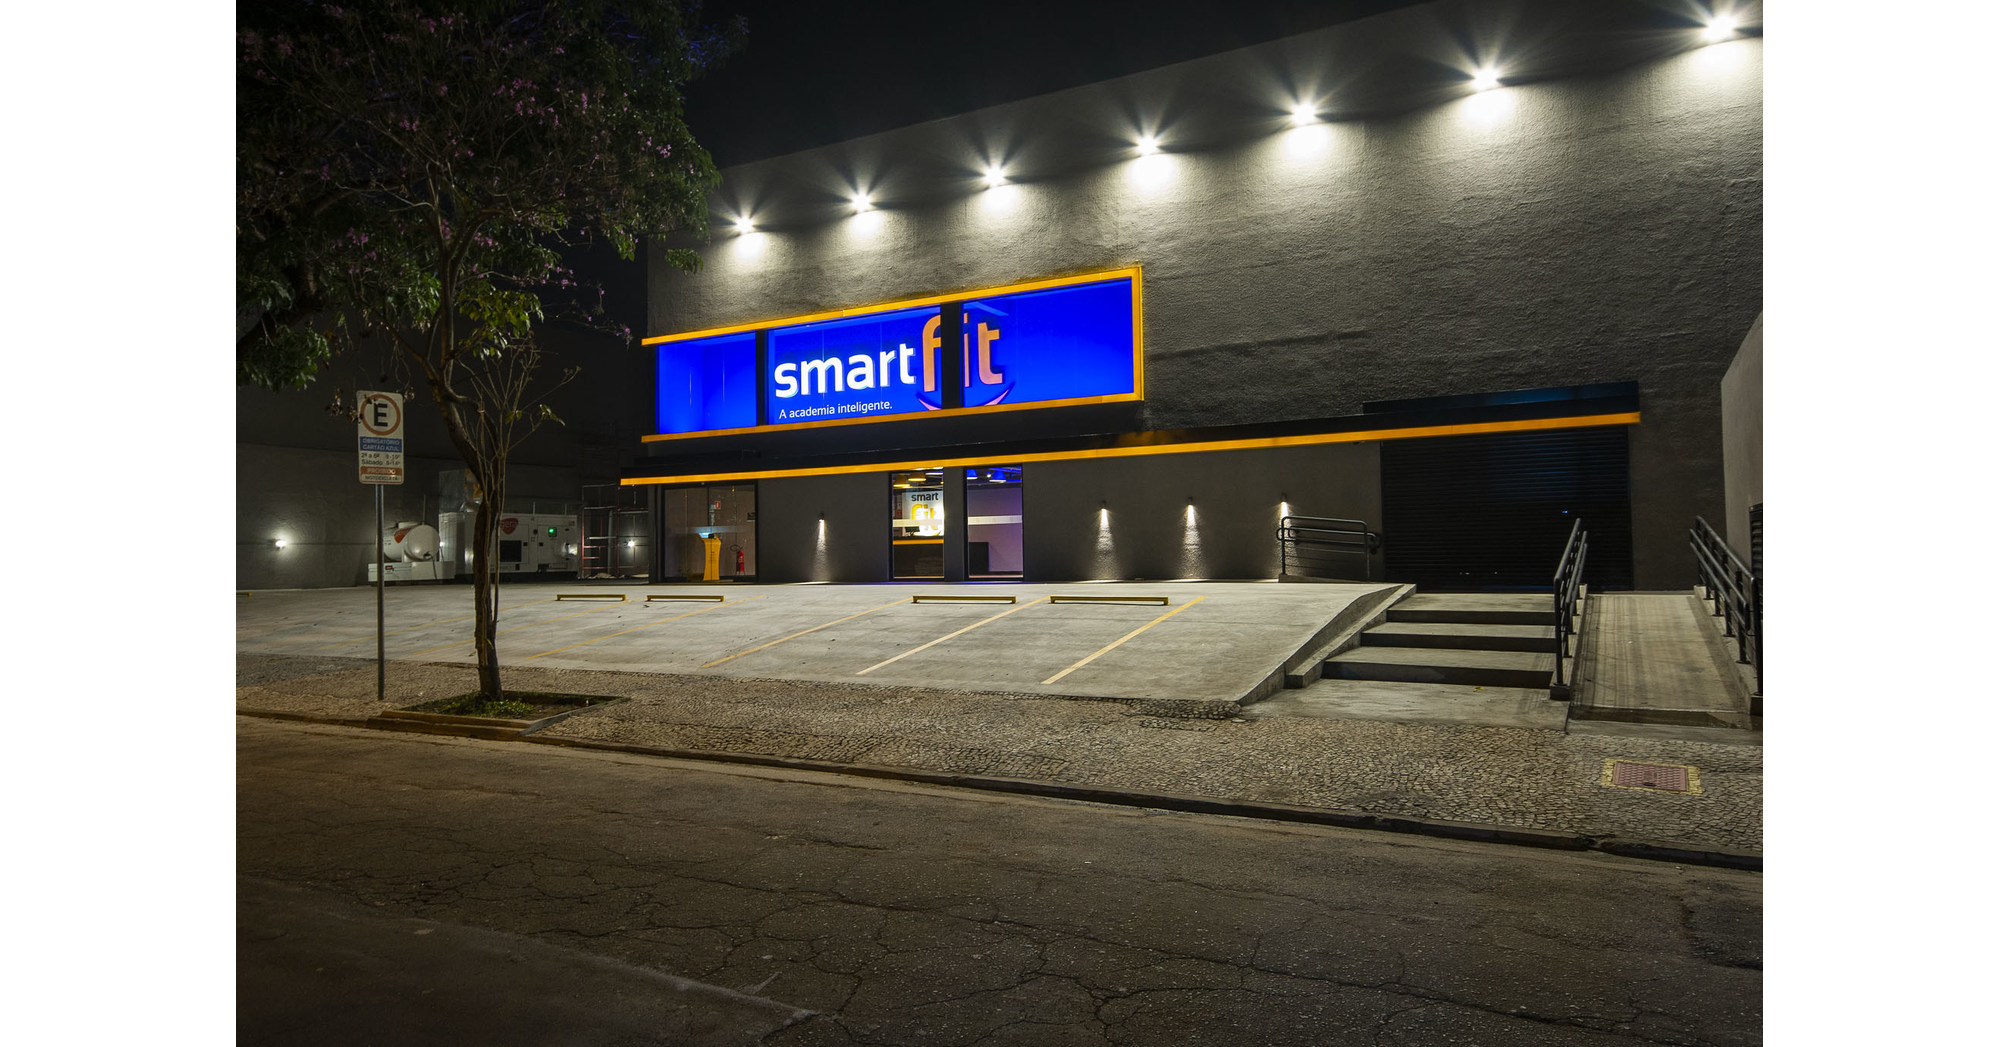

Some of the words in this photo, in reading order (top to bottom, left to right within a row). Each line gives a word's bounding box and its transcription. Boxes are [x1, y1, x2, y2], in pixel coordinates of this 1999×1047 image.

[774, 343, 916, 398] smart
[373, 403, 388, 427] E
[779, 409, 787, 419] A
[789, 404, 835, 418] academia
[837, 401, 893, 415] inteligente.
[911, 492, 939, 502] smart
